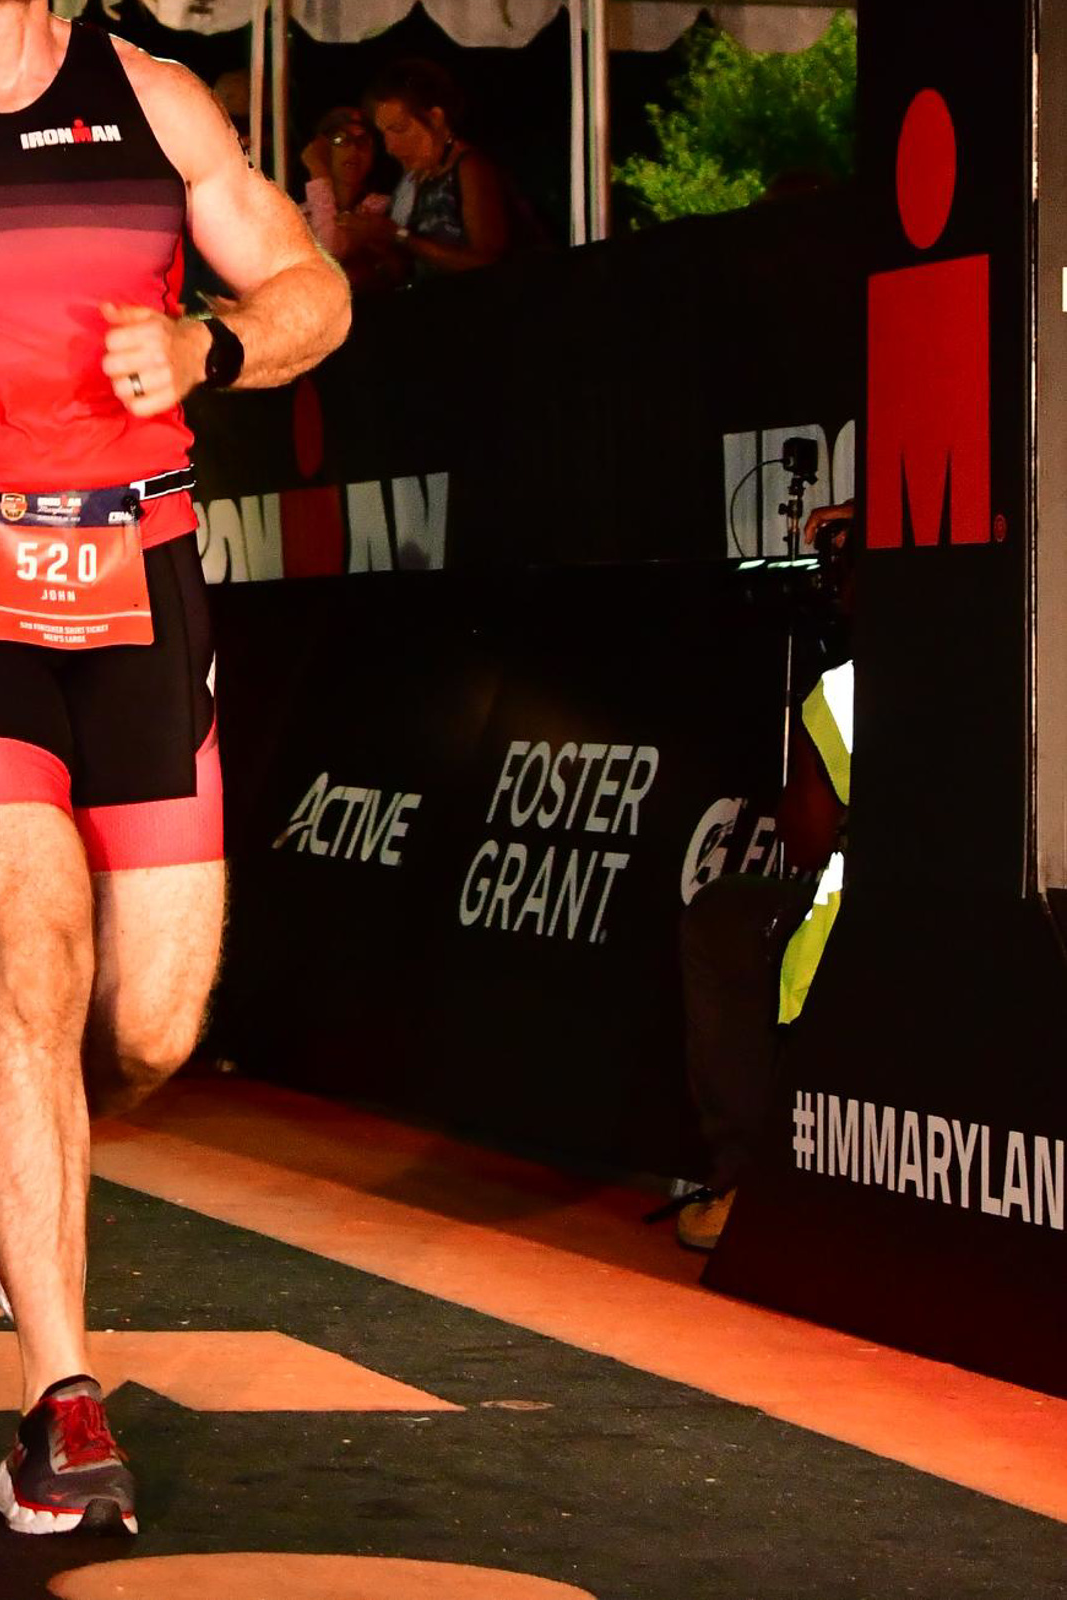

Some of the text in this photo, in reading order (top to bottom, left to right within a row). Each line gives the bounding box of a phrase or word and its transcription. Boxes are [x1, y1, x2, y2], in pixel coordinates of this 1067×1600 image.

[20, 119, 122, 150] IRONMAN
[16, 542, 97, 583] 520
[40, 589, 76, 602] JOHN
[272, 772, 422, 866] ACTIVE
[486, 741, 659, 835] FOSTER
[793, 1090, 1064, 1231] #IMMARYLAN
